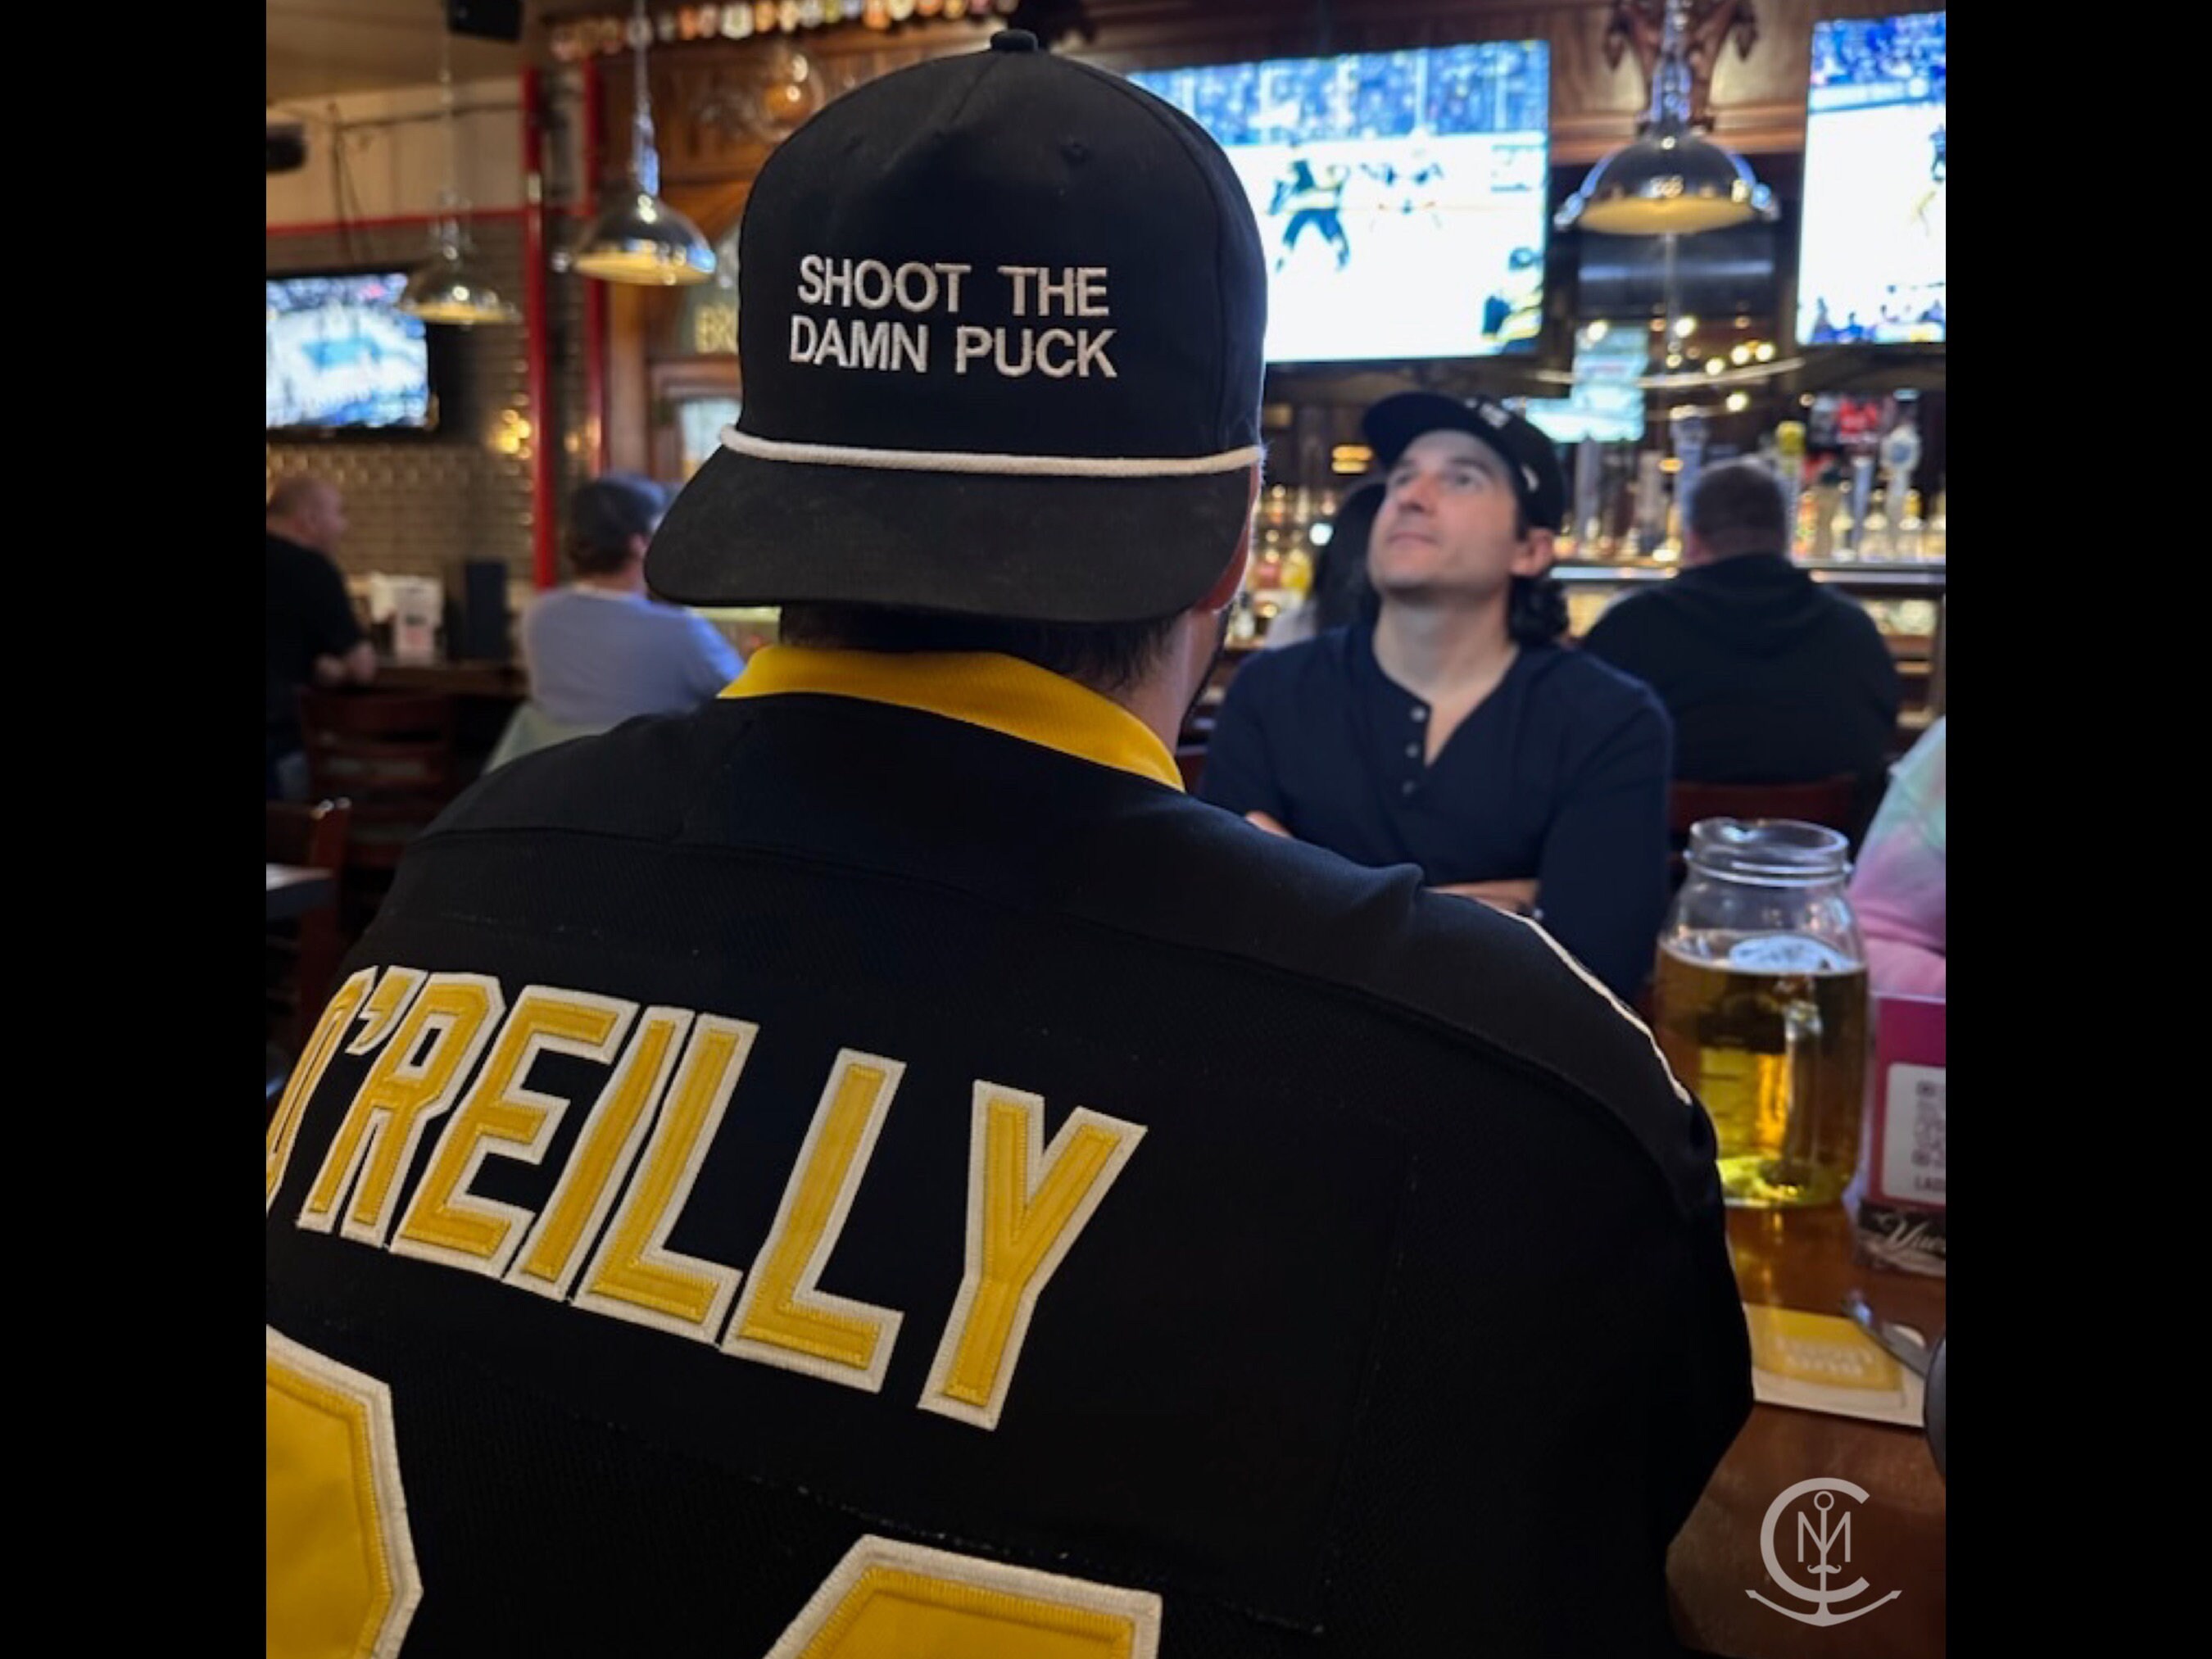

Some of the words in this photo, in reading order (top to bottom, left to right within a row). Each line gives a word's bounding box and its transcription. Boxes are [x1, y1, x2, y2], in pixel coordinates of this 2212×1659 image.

[798, 255, 972, 313] SHOOT
[998, 266, 1109, 316] THE
[790, 315, 927, 374] DAMN
[955, 326, 1117, 378] PUCK
[266, 965, 1148, 1430] O'REILLY
